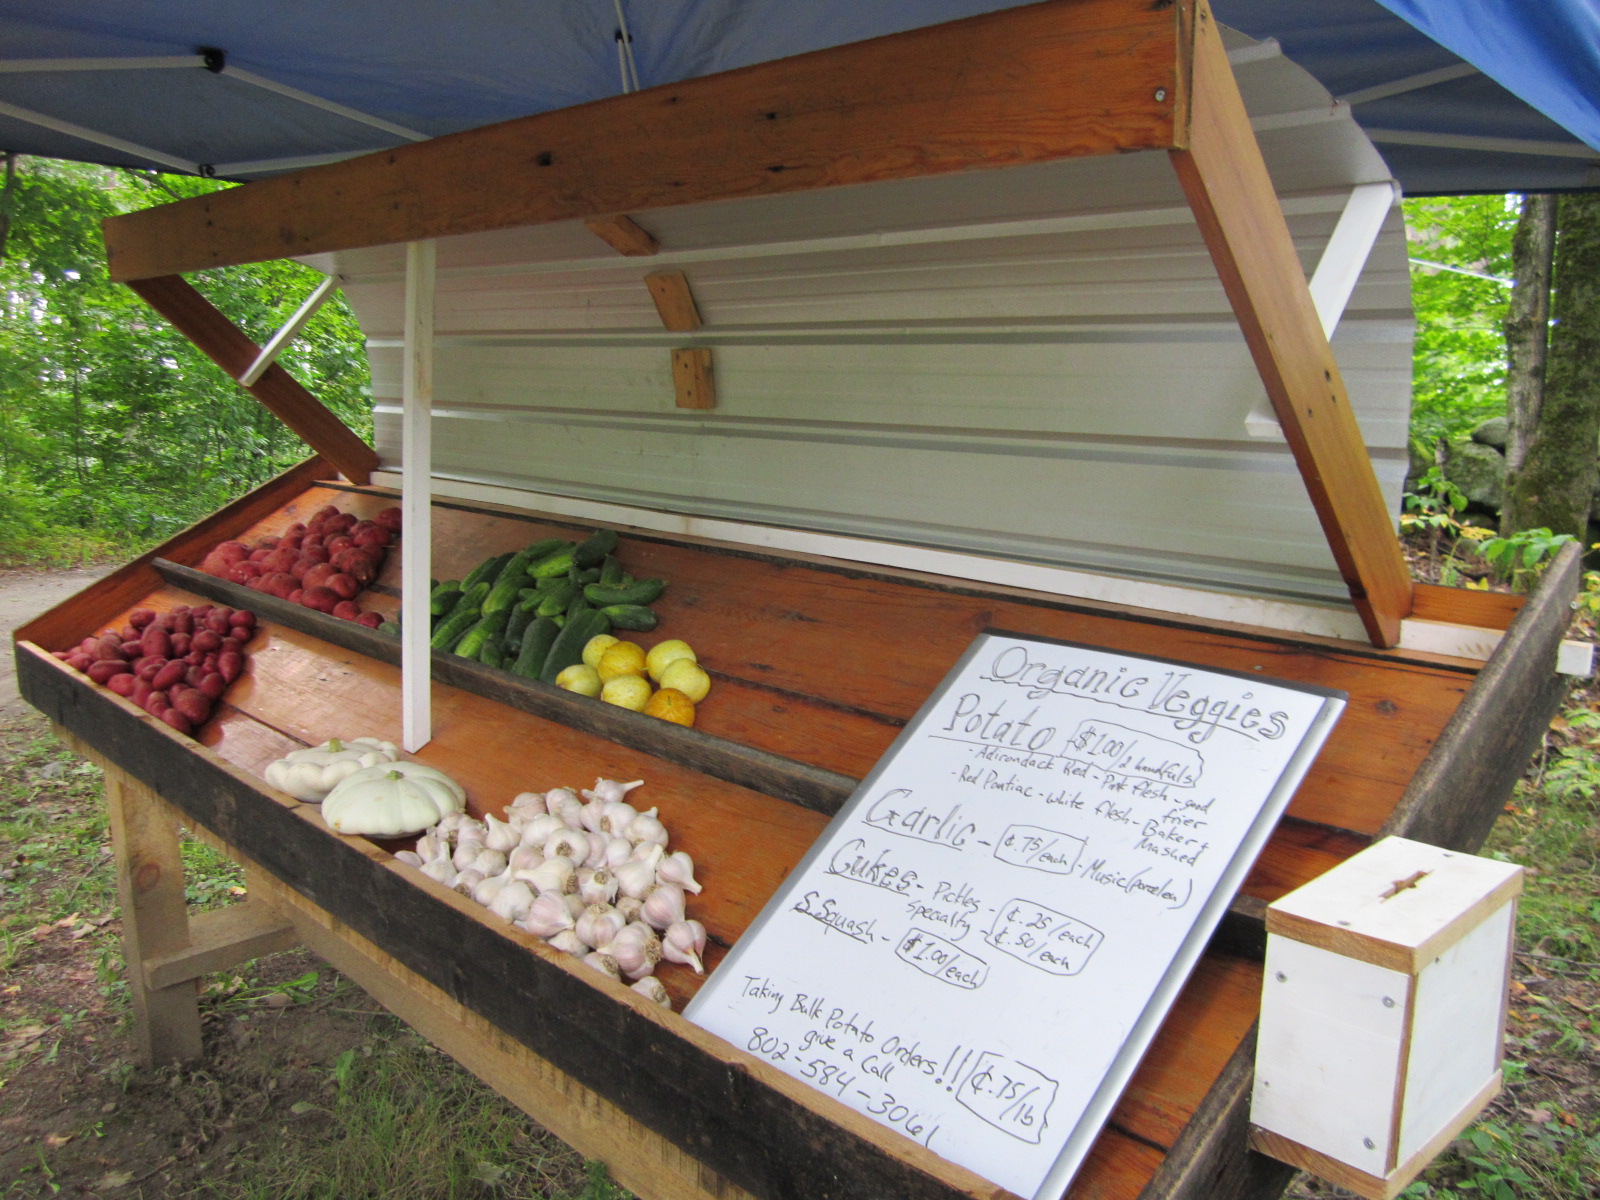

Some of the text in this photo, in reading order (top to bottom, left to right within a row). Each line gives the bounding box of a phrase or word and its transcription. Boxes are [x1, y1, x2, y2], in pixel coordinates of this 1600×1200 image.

[943, 693, 1056, 750] Potato
[992, 646, 1289, 744] Organic Veggies
[975, 744, 1055, 770] Adirondack
[1063, 759, 1092, 779] Red
[865, 788, 976, 846] Garlic
[958, 764, 984, 785] Red
[983, 769, 1033, 797] Pontiac
[1094, 800, 1132, 824] flesh
[1141, 818, 1198, 846] Baker
[828, 838, 918, 892] Cukes
[742, 975, 784, 1014] Taking
[789, 993, 824, 1019] Bulk
[825, 1008, 874, 1043] Potato
[799, 1030, 837, 1051] give
[843, 1049, 853, 1061] a
[748, 1027, 940, 1148] 802-584-3061
